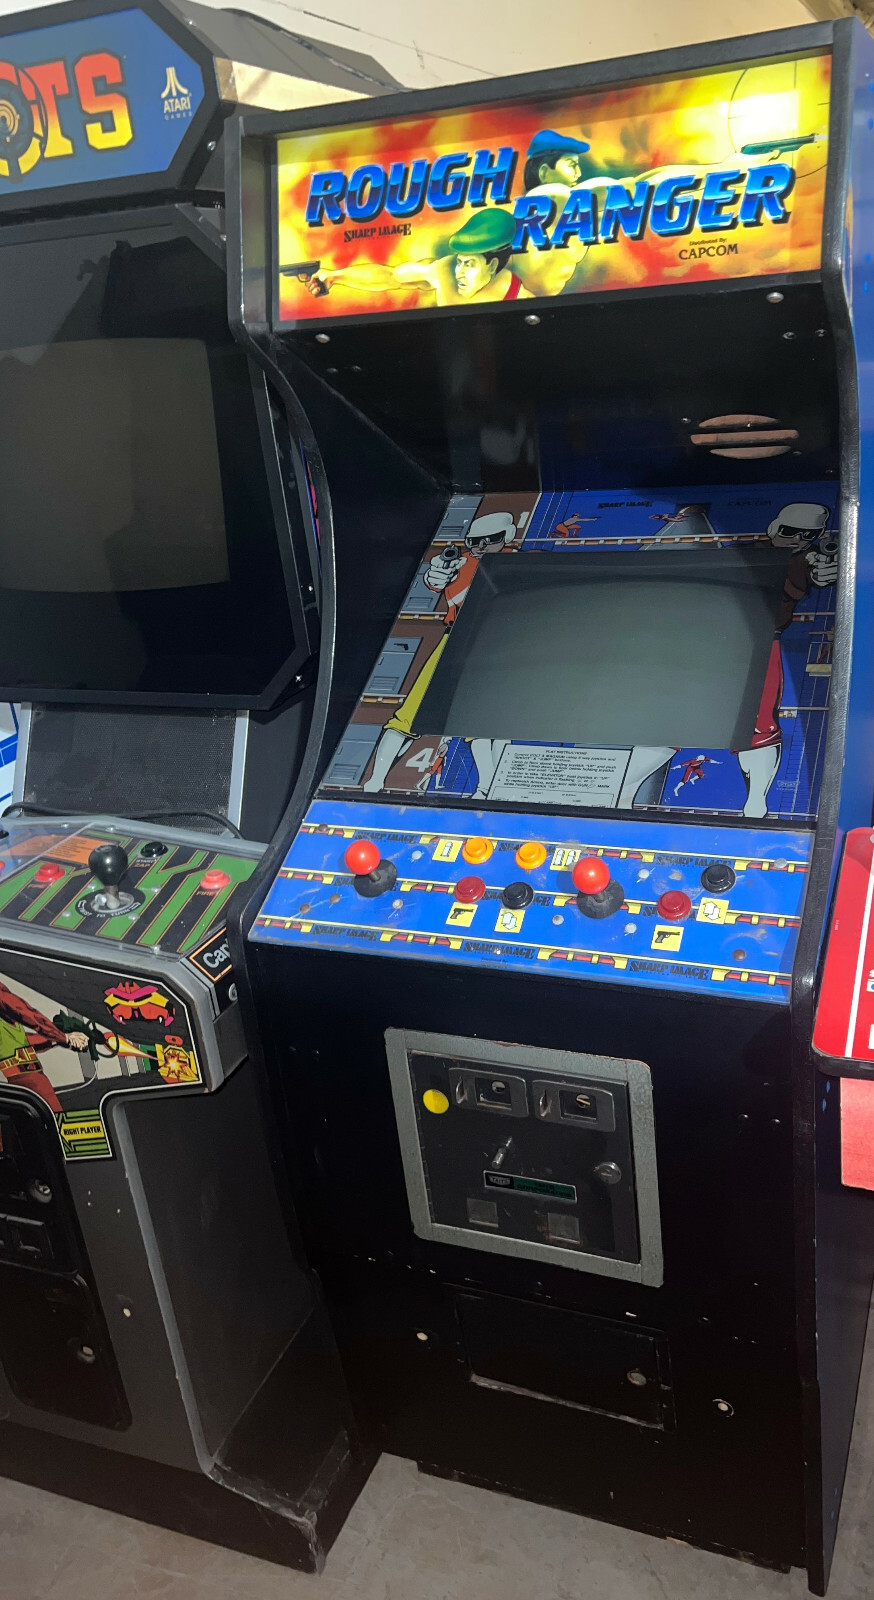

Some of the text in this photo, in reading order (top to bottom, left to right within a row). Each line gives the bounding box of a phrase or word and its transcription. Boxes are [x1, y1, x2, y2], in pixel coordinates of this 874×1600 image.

[163, 96, 191, 114] ATARI
[164, 112, 192, 121] GAMES
[305, 147, 518, 227] ROUGH
[512, 163, 796, 254] RANGER
[344, 227, 376, 243] SHARP
[378, 223, 411, 236] IMAGE
[678, 243, 739, 260] CAPCOM
[405, 747, 434, 773] 4
[63, 1126, 101, 1136] RIGHT PLAYER
